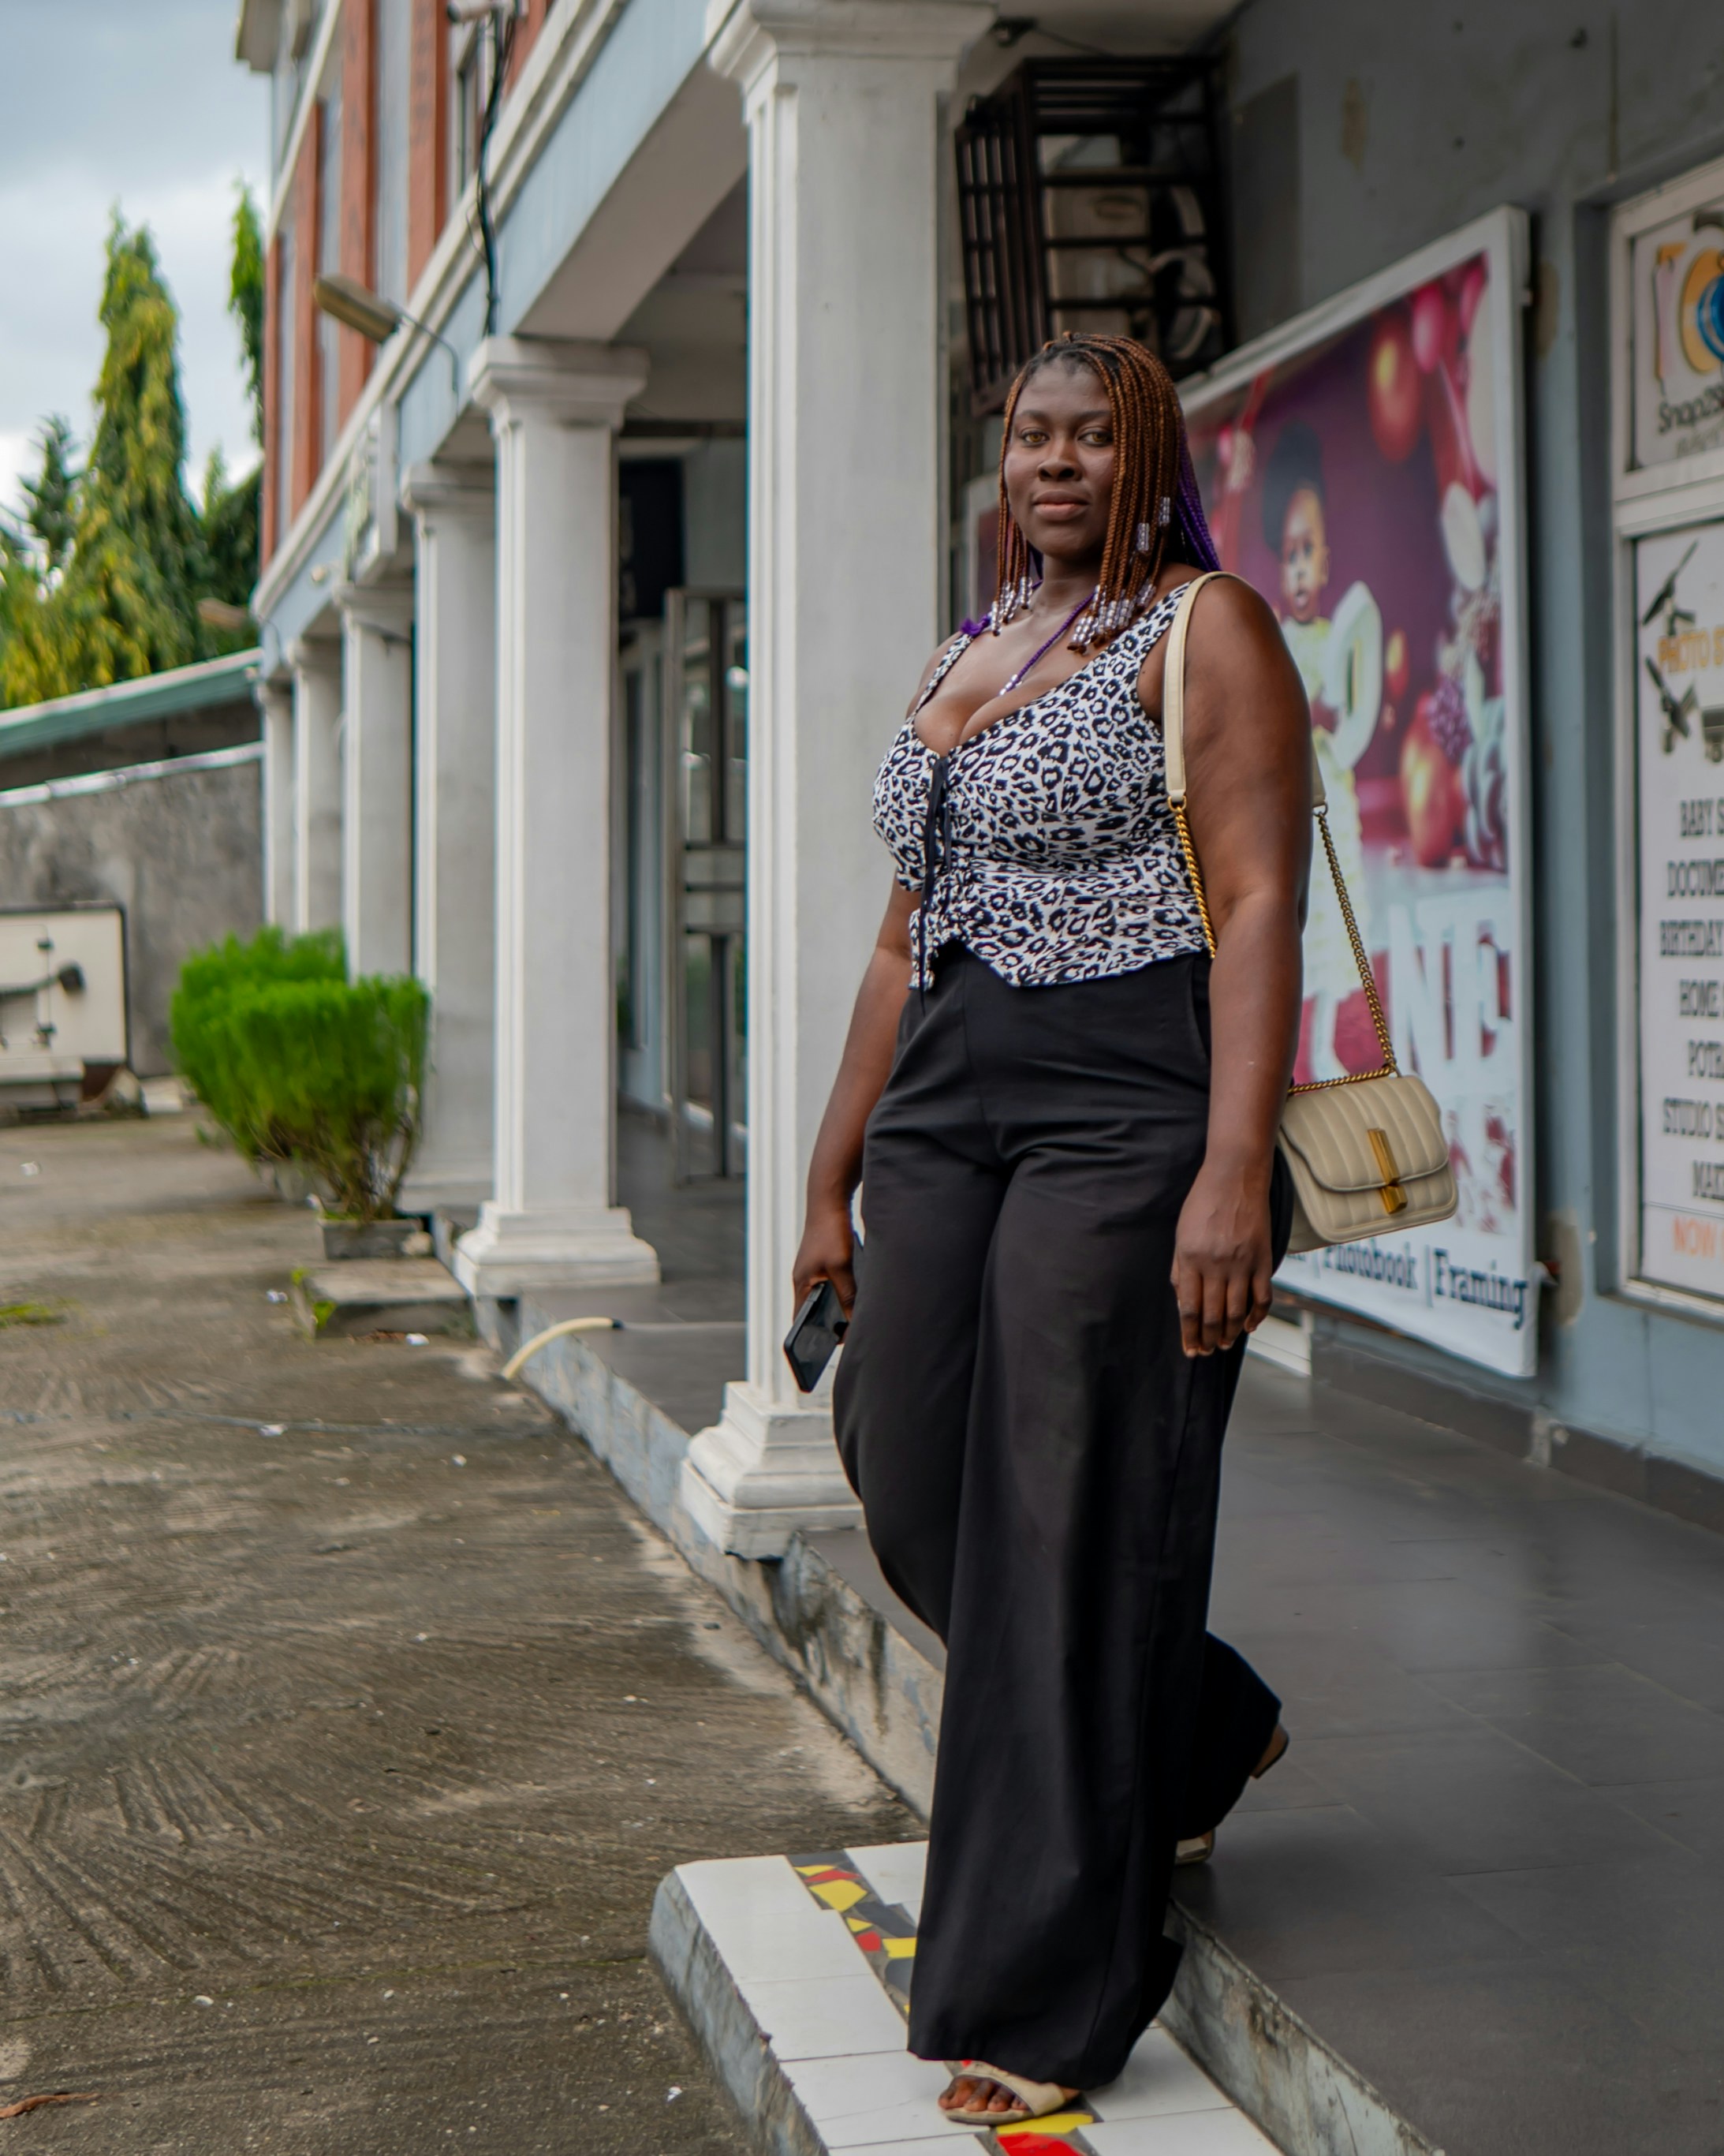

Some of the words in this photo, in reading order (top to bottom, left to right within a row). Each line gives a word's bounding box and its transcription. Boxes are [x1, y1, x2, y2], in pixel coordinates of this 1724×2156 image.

[1658, 629, 1709, 672] PHOTO
[1680, 798, 1713, 836] BABY
[1659, 920, 1722, 956] BIRTHDAY
[1679, 979, 1718, 1017] HOME
[1663, 1097, 1712, 1139] STUDIO
[1673, 1216, 1717, 1260] NOW
[1433, 1247, 1529, 1331] Framing
